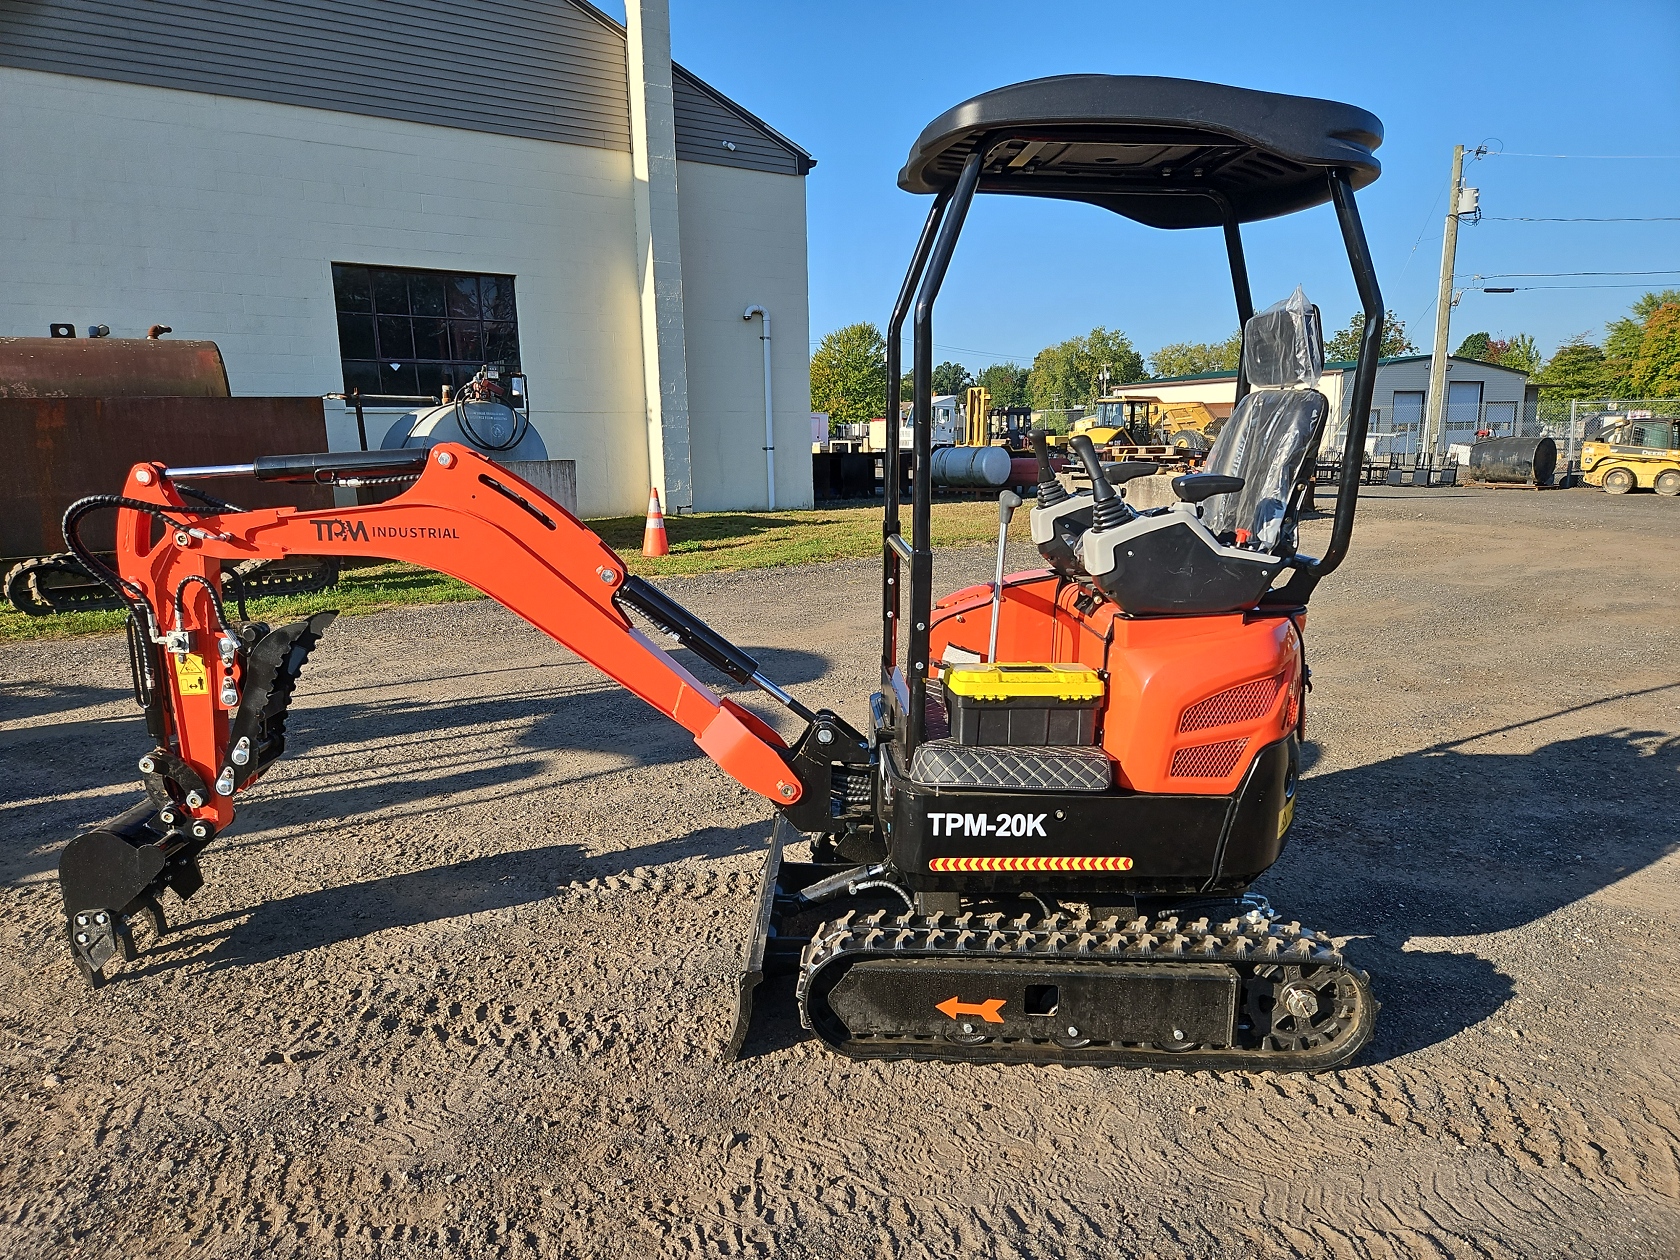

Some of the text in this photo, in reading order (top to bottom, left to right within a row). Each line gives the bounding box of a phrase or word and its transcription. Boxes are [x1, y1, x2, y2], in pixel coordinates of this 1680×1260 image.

[1641, 449, 1667, 457] DEERE
[310, 519, 460, 542] TPM INDUSTRIAL
[927, 812, 1048, 837] TPM-20K
